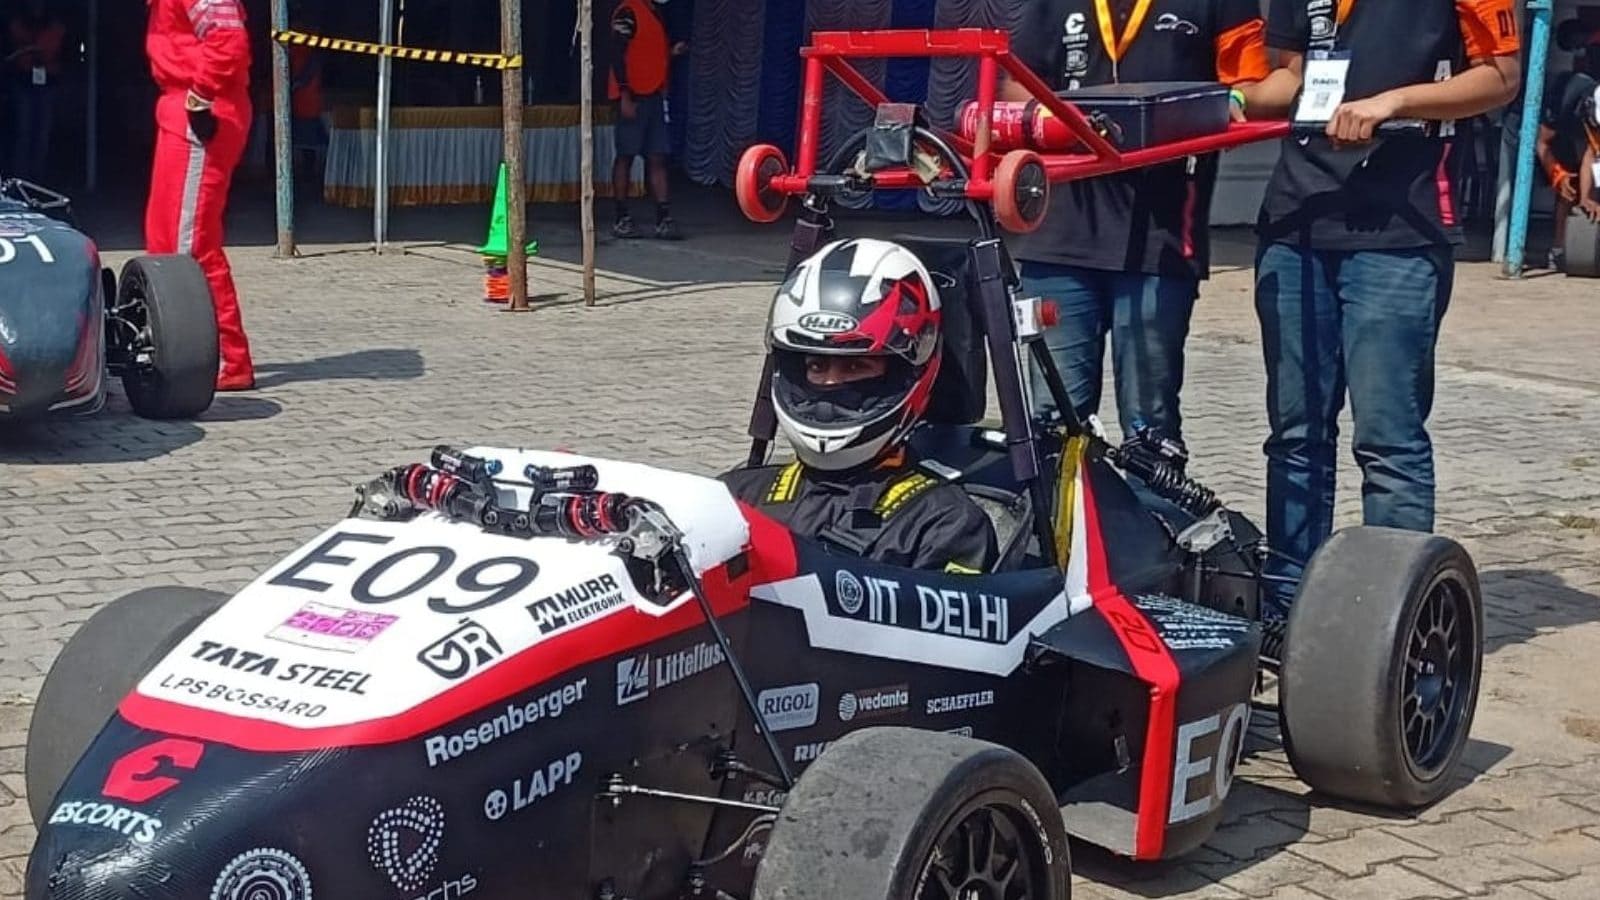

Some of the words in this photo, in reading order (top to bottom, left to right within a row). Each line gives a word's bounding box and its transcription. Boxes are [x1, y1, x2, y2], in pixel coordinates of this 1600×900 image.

[266, 531, 540, 614] E09
[555, 573, 619, 609] MURR
[567, 592, 625, 623] ELEKTRONIK
[863, 576, 900, 624] IIT
[916, 585, 1008, 642] DELHI
[191, 641, 279, 676] TATA
[277, 663, 372, 695] STEEL
[763, 690, 814, 715] RIGOL
[858, 689, 909, 710] vedanta
[926, 690, 994, 714] SCHAEFFLER
[425, 678, 587, 767] Rosenberger
[513, 752, 582, 810] LAPP
[48, 801, 163, 843] ESCORTS
